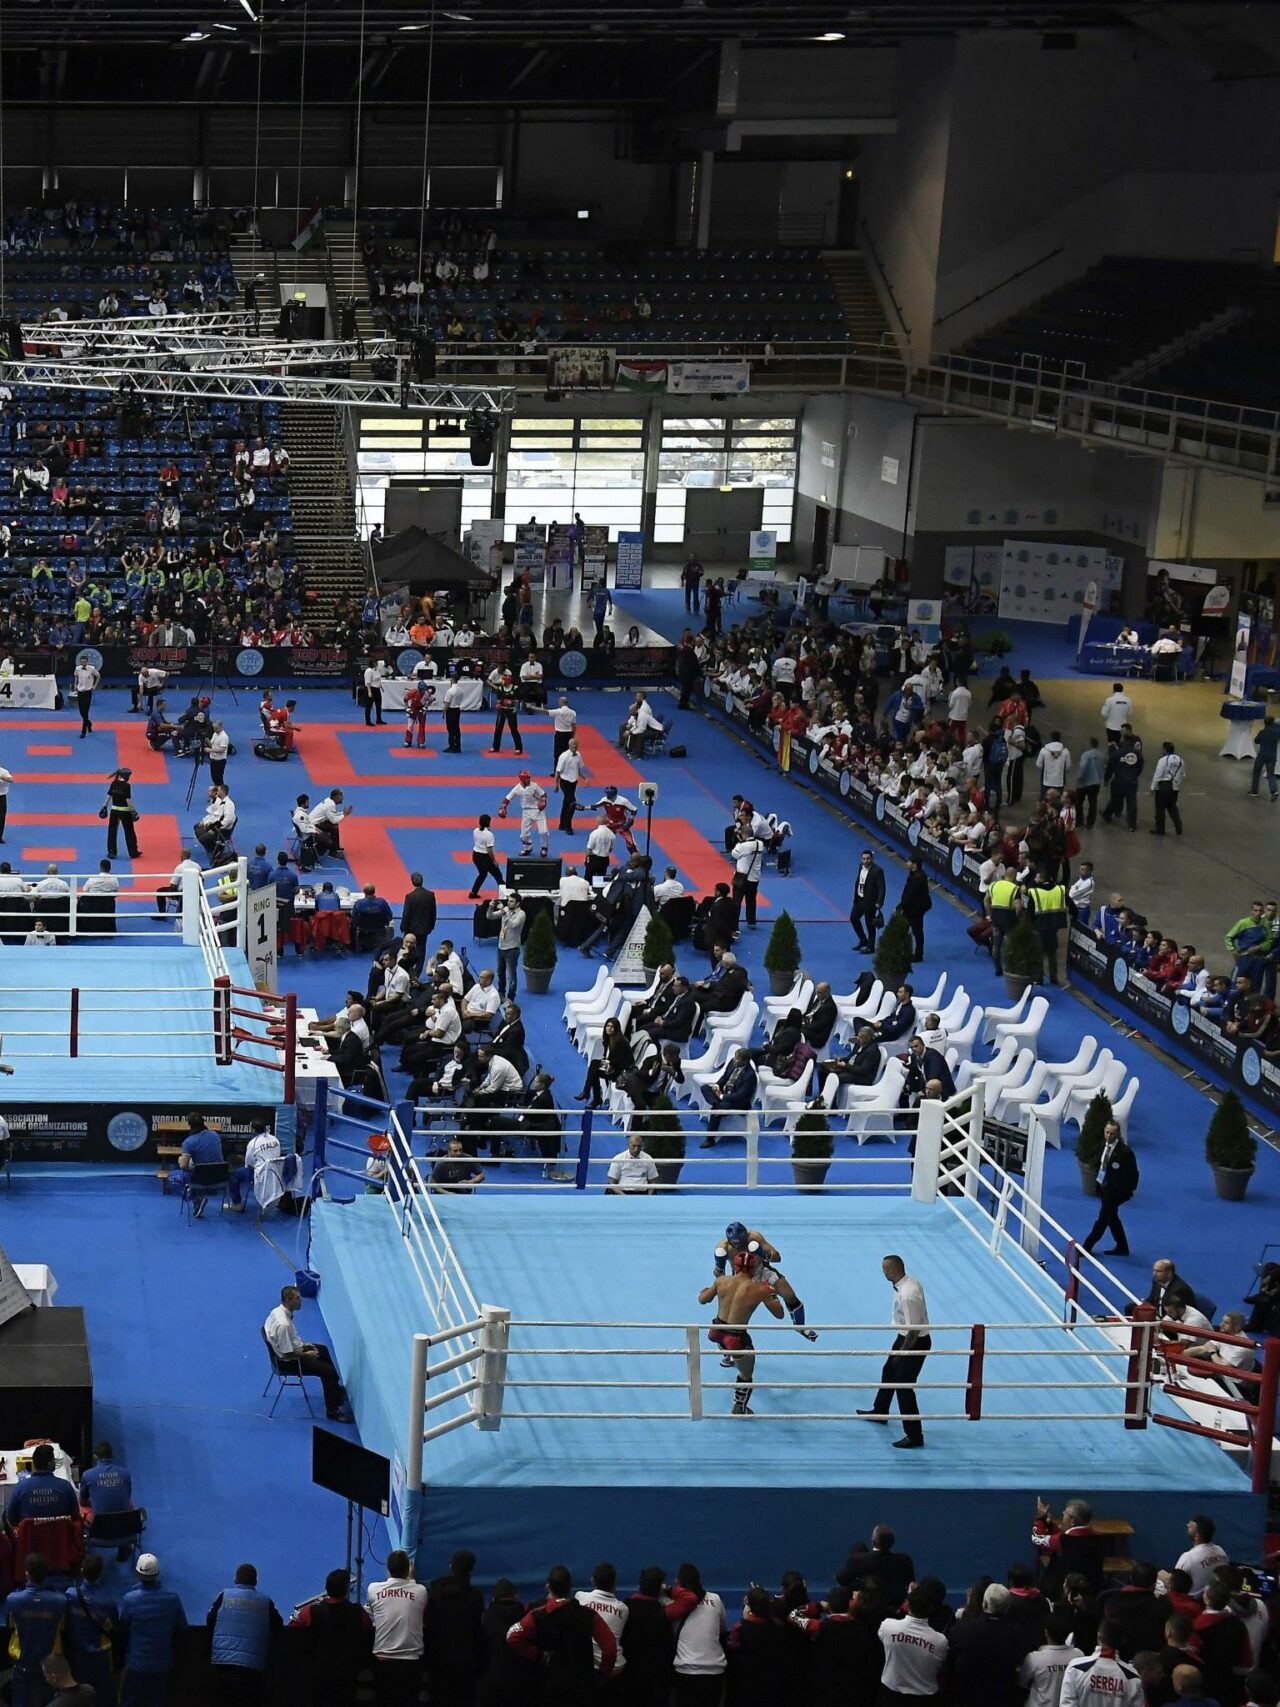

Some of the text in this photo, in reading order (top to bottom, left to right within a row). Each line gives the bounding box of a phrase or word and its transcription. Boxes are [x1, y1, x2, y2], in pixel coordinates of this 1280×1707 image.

[0, 682, 13, 699] 4
[254, 898, 271, 912] RING
[257, 912, 268, 945] 1
[28, 1122, 88, 1131] ORGANIZATIONS
[260, 1141, 279, 1152] ITALIA
[376, 1587, 416, 1601] TÜRKİYE
[890, 1633, 937, 1654] TÜRKİYE
[1089, 1674, 1124, 1694] SERBIA
